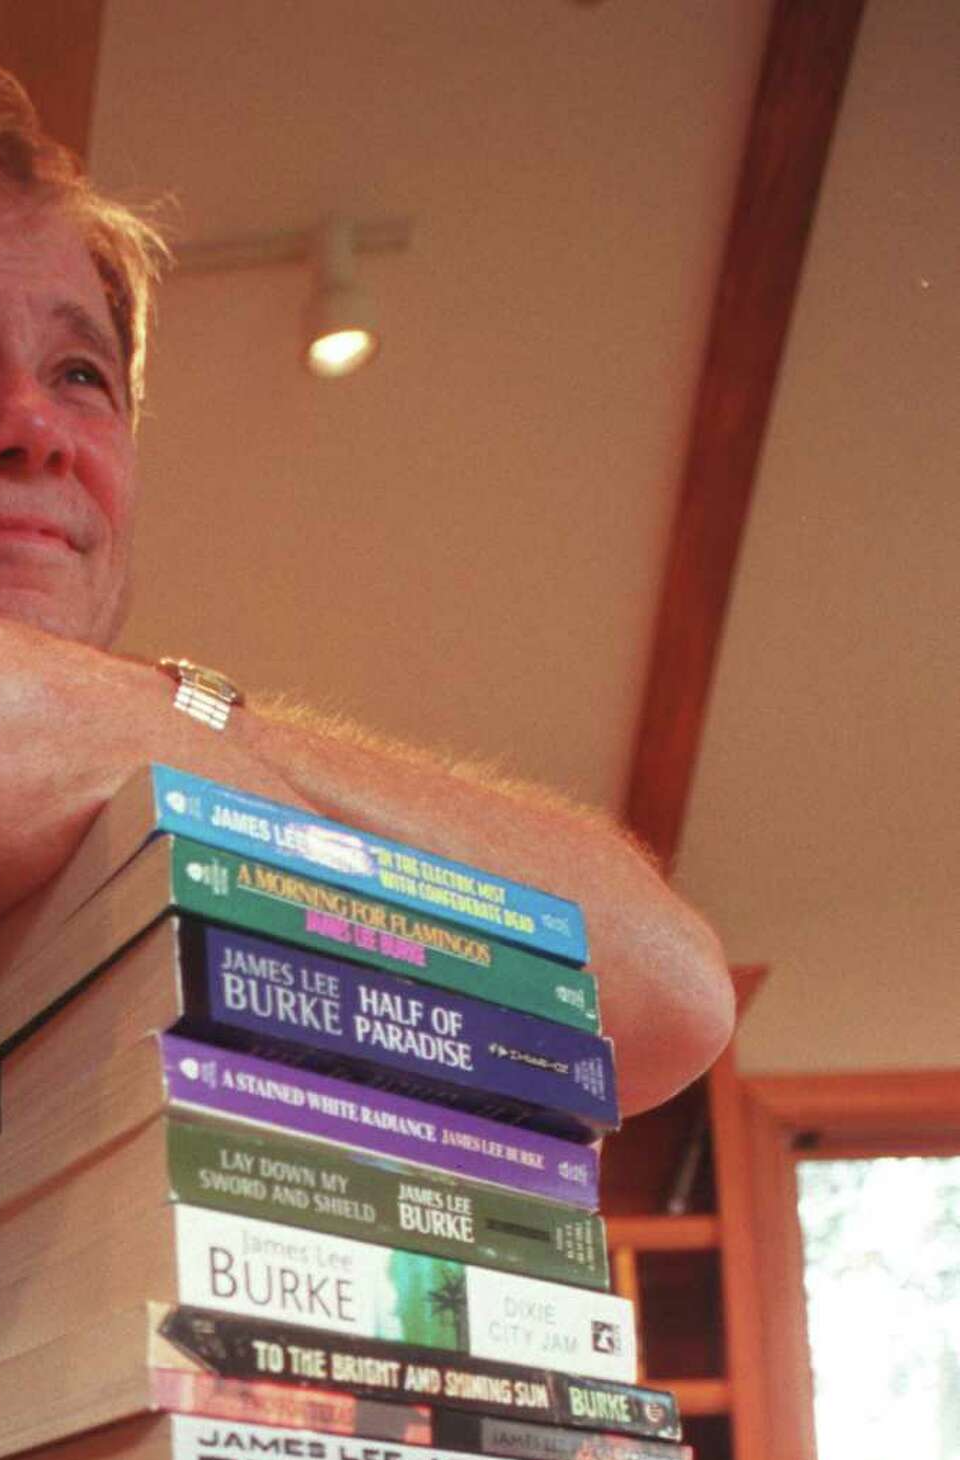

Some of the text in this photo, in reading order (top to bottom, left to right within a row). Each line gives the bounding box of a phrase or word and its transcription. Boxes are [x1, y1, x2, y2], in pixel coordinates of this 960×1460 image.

[211, 805, 271, 842] JAMES
[237, 863, 251, 885] A
[253, 867, 349, 920] MORNING
[350, 900, 386, 928] FOR
[391, 913, 491, 966] FLAMINGOS
[503, 909, 535, 934] DEAD
[221, 948, 340, 999] JAMES LEE
[222, 972, 343, 1036] BURKE
[357, 985, 463, 1037] HALF OF
[354, 1015, 474, 1072] PARADISE
[221, 1069, 234, 1089] A
[236, 1072, 307, 1107] STAINED
[306, 1089, 359, 1123] WHITE
[360, 1105, 438, 1143] RADIANCE
[442, 1128, 481, 1152] JAMES
[481, 1138, 505, 1159] LEE
[505, 1145, 546, 1171] BURKE
[220, 1149, 350, 1195] LAY DOWN MY
[197, 1168, 377, 1223] SWORD AND SHIELD
[397, 1182, 474, 1215] JAMES LEE
[397, 1201, 476, 1244] BURKE
[240, 1228, 355, 1272] James Lee
[207, 1244, 357, 1324] BURKE
[503, 1296, 558, 1326] DIXIE
[489, 1321, 580, 1354] CITY JAM
[251, 1339, 550, 1410] TO THE BRIGHT AND SHINING SUN
[568, 1386, 633, 1424] BURKE
[196, 1429, 327, 1460] JAMES
